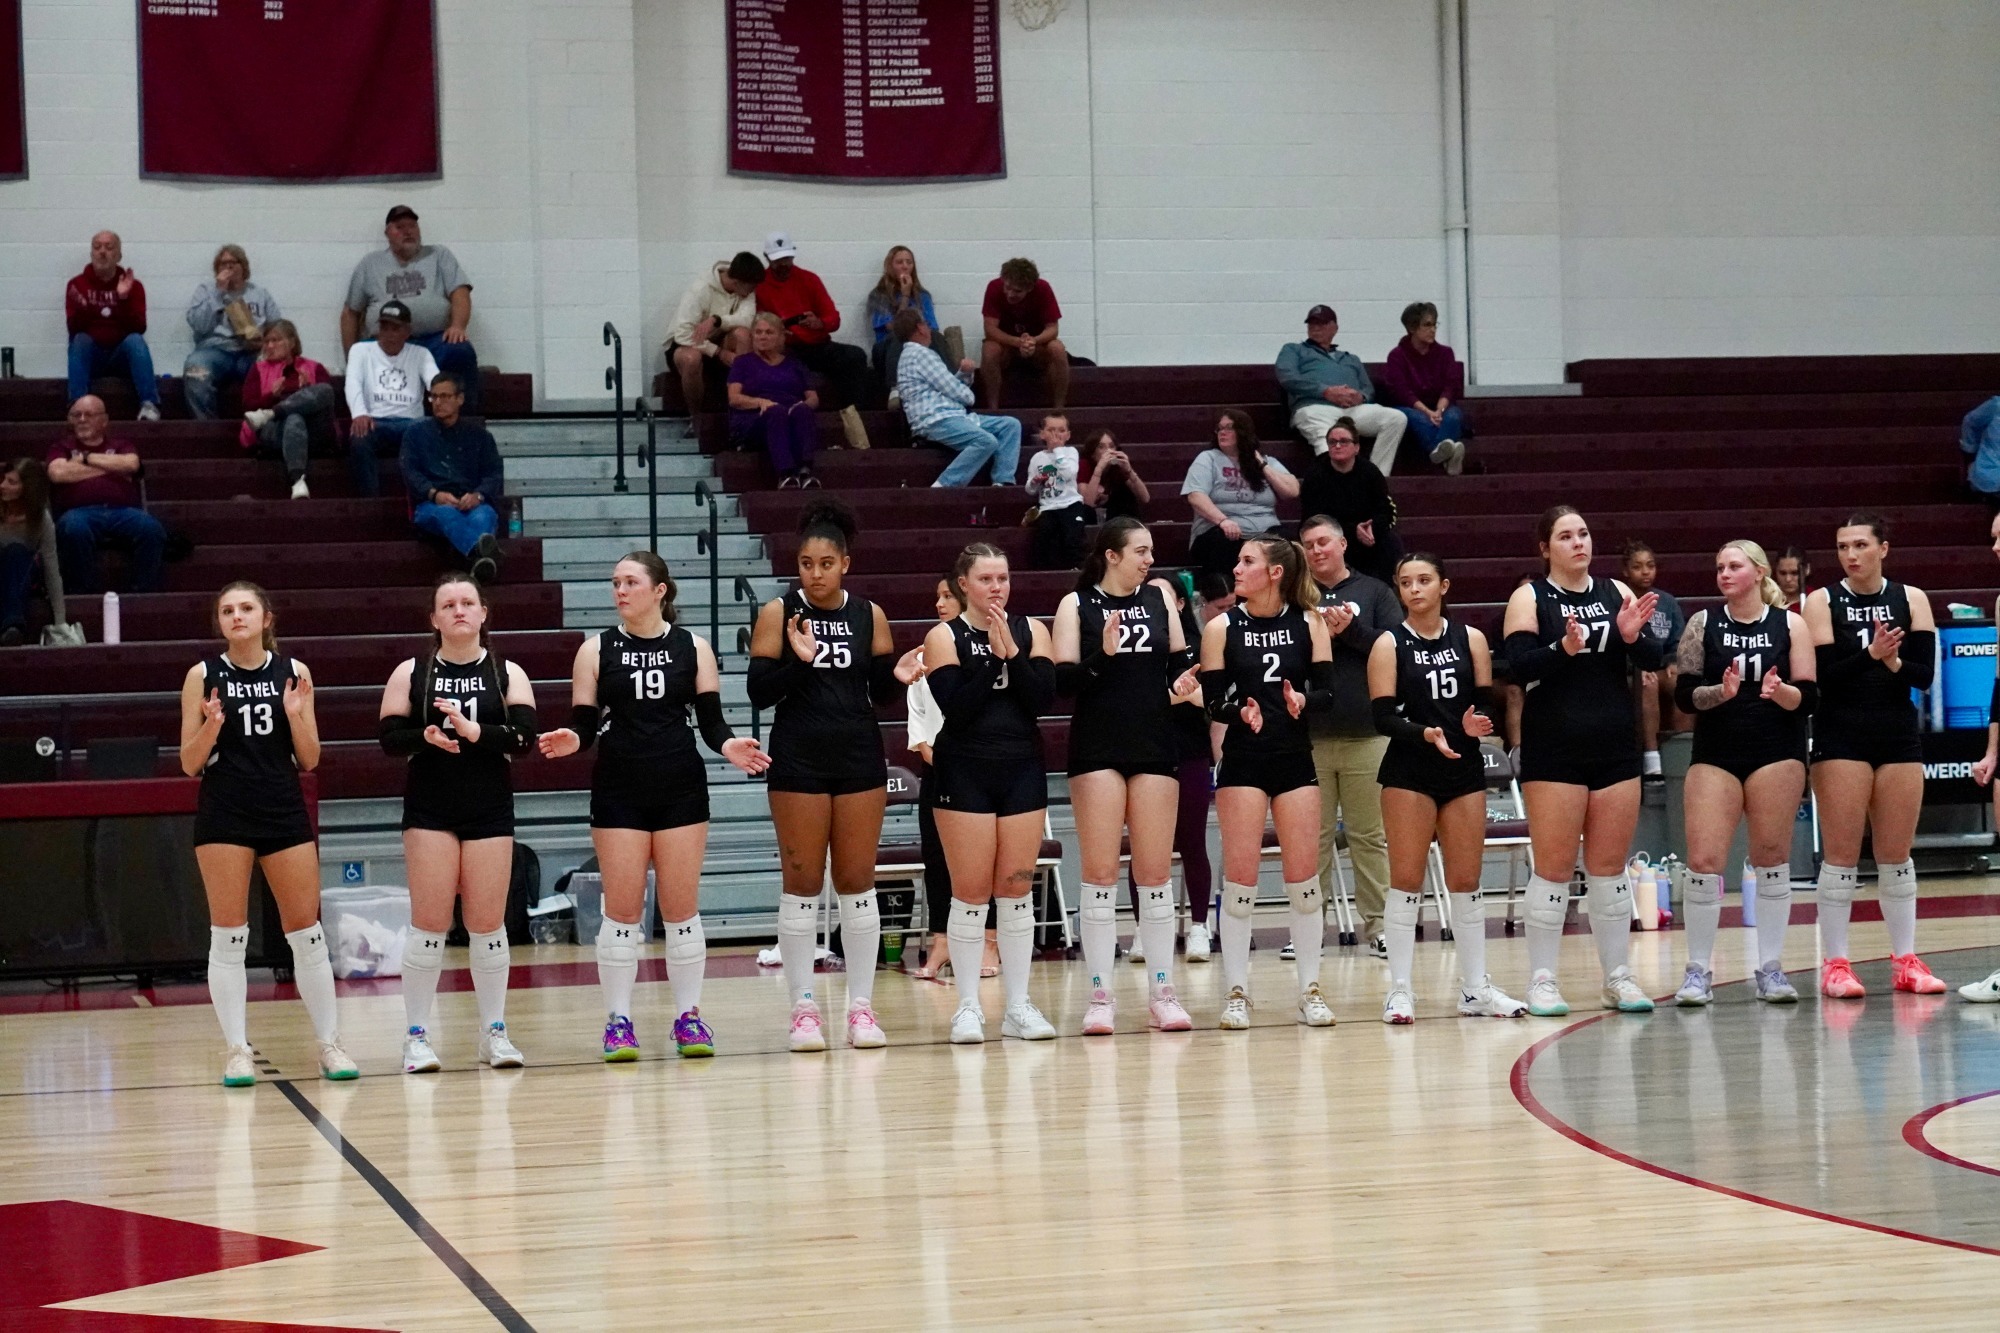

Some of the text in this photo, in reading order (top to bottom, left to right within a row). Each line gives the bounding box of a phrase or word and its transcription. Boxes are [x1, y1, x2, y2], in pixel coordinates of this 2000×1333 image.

[148, 5, 187, 15] CLIFFORD
[188, 7, 210, 16] BYRD
[264, 10, 283, 20] 2023
[867, 28, 888, 36] JOSH
[868, 48, 887, 56] TREY
[737, 62, 762, 70] JASON
[868, 54, 992, 66] TREY PALMER 2022
[868, 64, 993, 77] KEEGAN MARTIN 2022
[737, 82, 758, 90] ZACH
[869, 74, 994, 87] JOSH SEABOLT 2022
[737, 92, 760, 100] PETER
[869, 84, 994, 97] BRENDEN SANDERS 2022
[737, 102, 760, 111] PETER
[869, 99, 891, 107] RYAN
[737, 112, 772, 121] GARRETT
[737, 122, 760, 131] PETER
[737, 132, 759, 141] CHAD
[737, 142, 772, 152] GARRETT
[1102, 605, 1151, 621] BTHEL
[1560, 602, 1610, 619] BETHEL
[1846, 605, 1894, 622] BETHEL
[811, 620, 853, 636] ETHEL
[1116, 624, 1152, 653] 22
[1244, 629, 1294, 648] BETHEL
[1723, 633, 1773, 649] BETHEL
[622, 650, 672, 667] BETHEL
[813, 640, 852, 669] 25
[1262, 653, 1282, 683] 2
[1738, 653, 1762, 682] 11
[227, 681, 279, 698] BETHEL
[435, 677, 486, 693] BETHEL
[630, 669, 666, 700] 19
[1425, 668, 1458, 700] 15
[238, 703, 273, 736] 13
